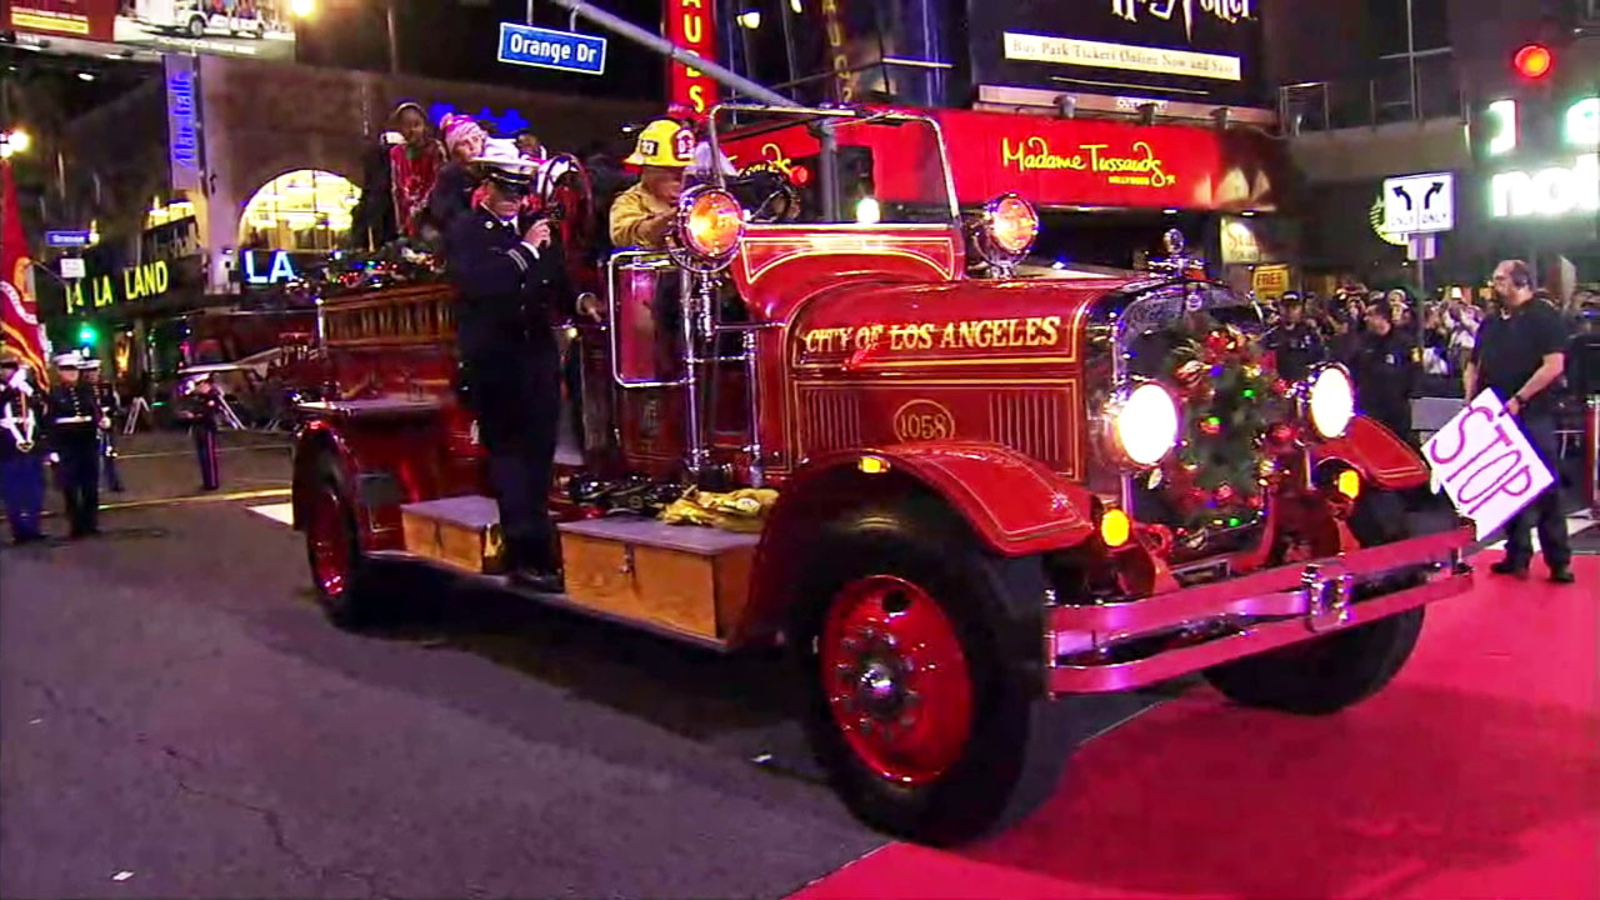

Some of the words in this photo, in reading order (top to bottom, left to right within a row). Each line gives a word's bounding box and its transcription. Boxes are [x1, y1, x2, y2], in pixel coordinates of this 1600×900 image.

[510, 33, 570, 64] Orange
[577, 45, 597, 63] Dr
[1042, 41, 1069, 56] Park
[1002, 136, 1088, 172] Madame
[1079, 141, 1162, 187] Tussauds
[93, 275, 113, 307] LA
[124, 260, 168, 300] LAND
[245, 250, 296, 284] LA
[805, 327, 854, 353] CITY
[855, 324, 884, 350] OF
[889, 323, 935, 351] LOS
[939, 316, 1061, 349] ANGELES
[900, 412, 947, 440] 1058
[1430, 406, 1532, 515] STOP
